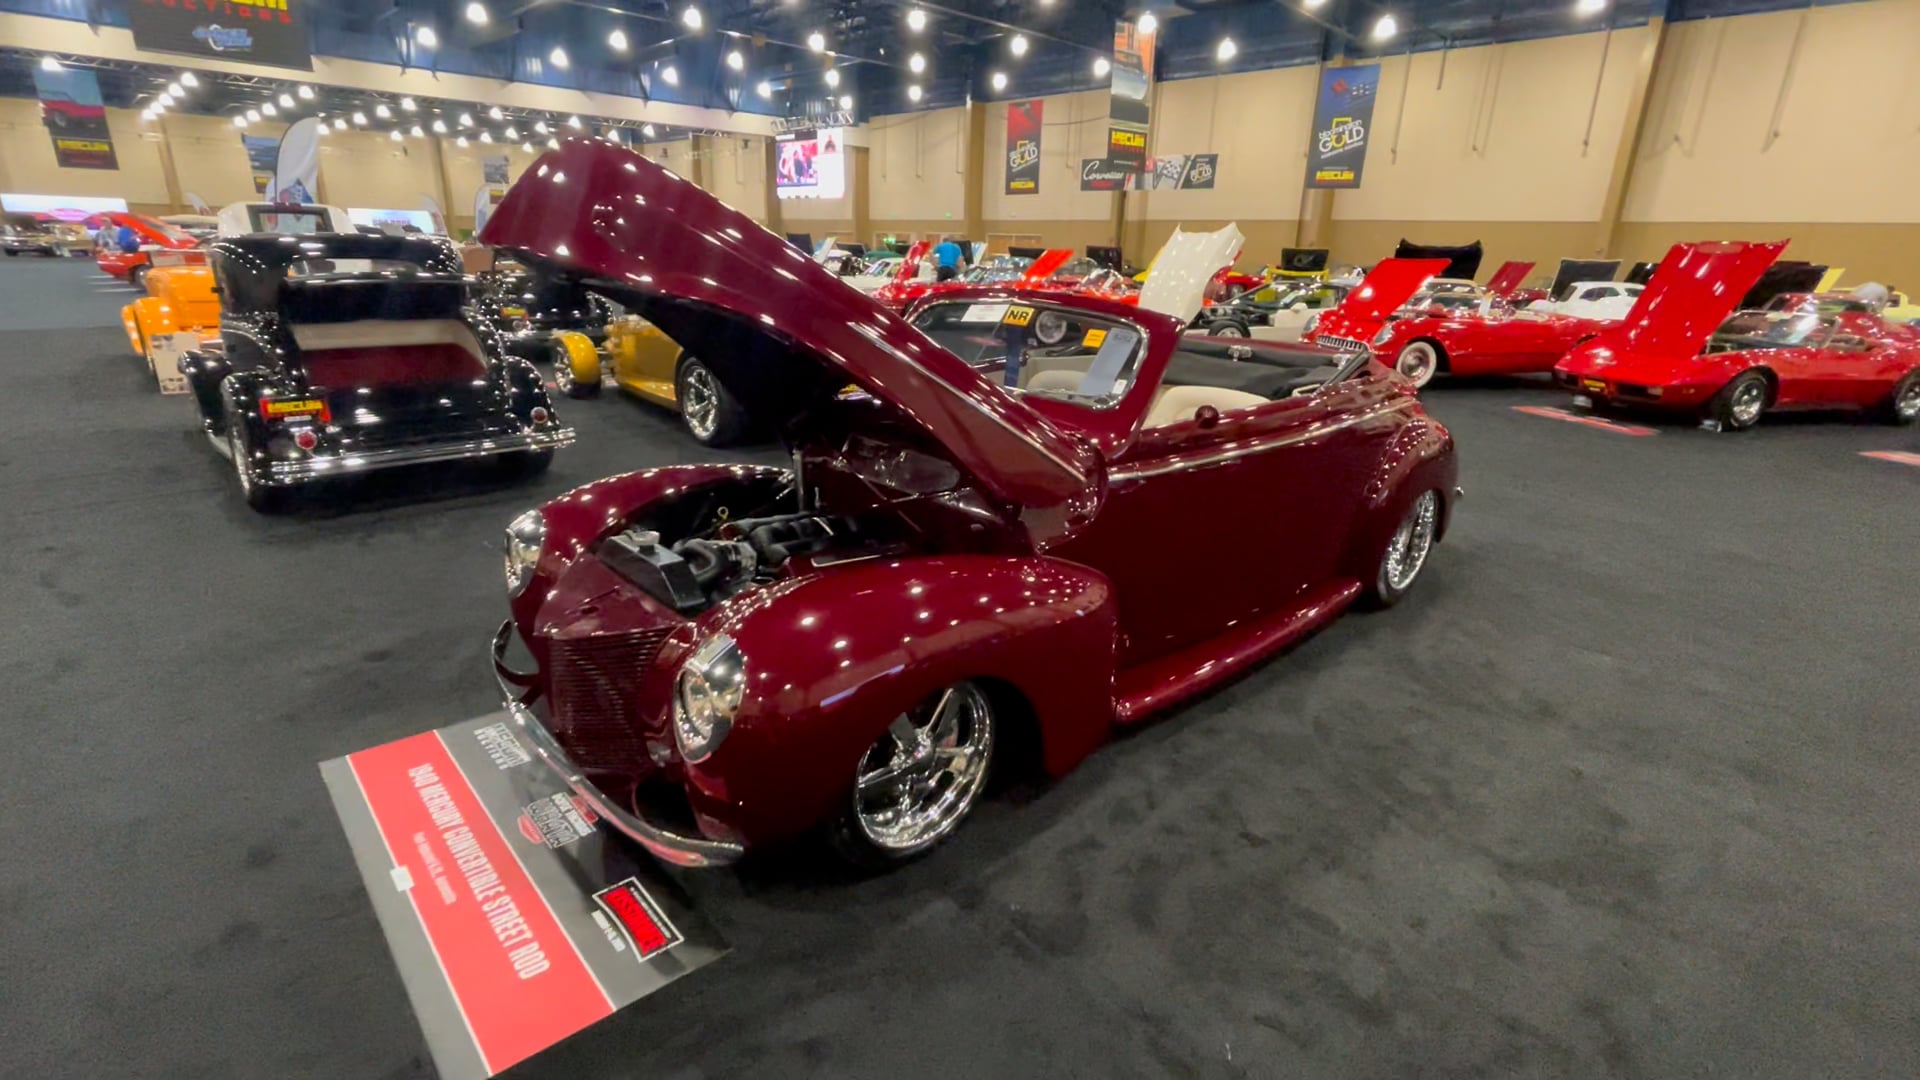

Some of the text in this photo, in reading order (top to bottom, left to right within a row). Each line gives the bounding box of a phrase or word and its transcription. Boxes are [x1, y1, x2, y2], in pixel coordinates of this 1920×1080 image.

[1008, 309, 1030, 321] NR
[408, 763, 440, 788] 1940
[419, 782, 465, 831] MERCURY
[443, 826, 506, 902] CONVERTIBLE
[481, 895, 533, 948] STREET
[508, 941, 551, 980] ROD
